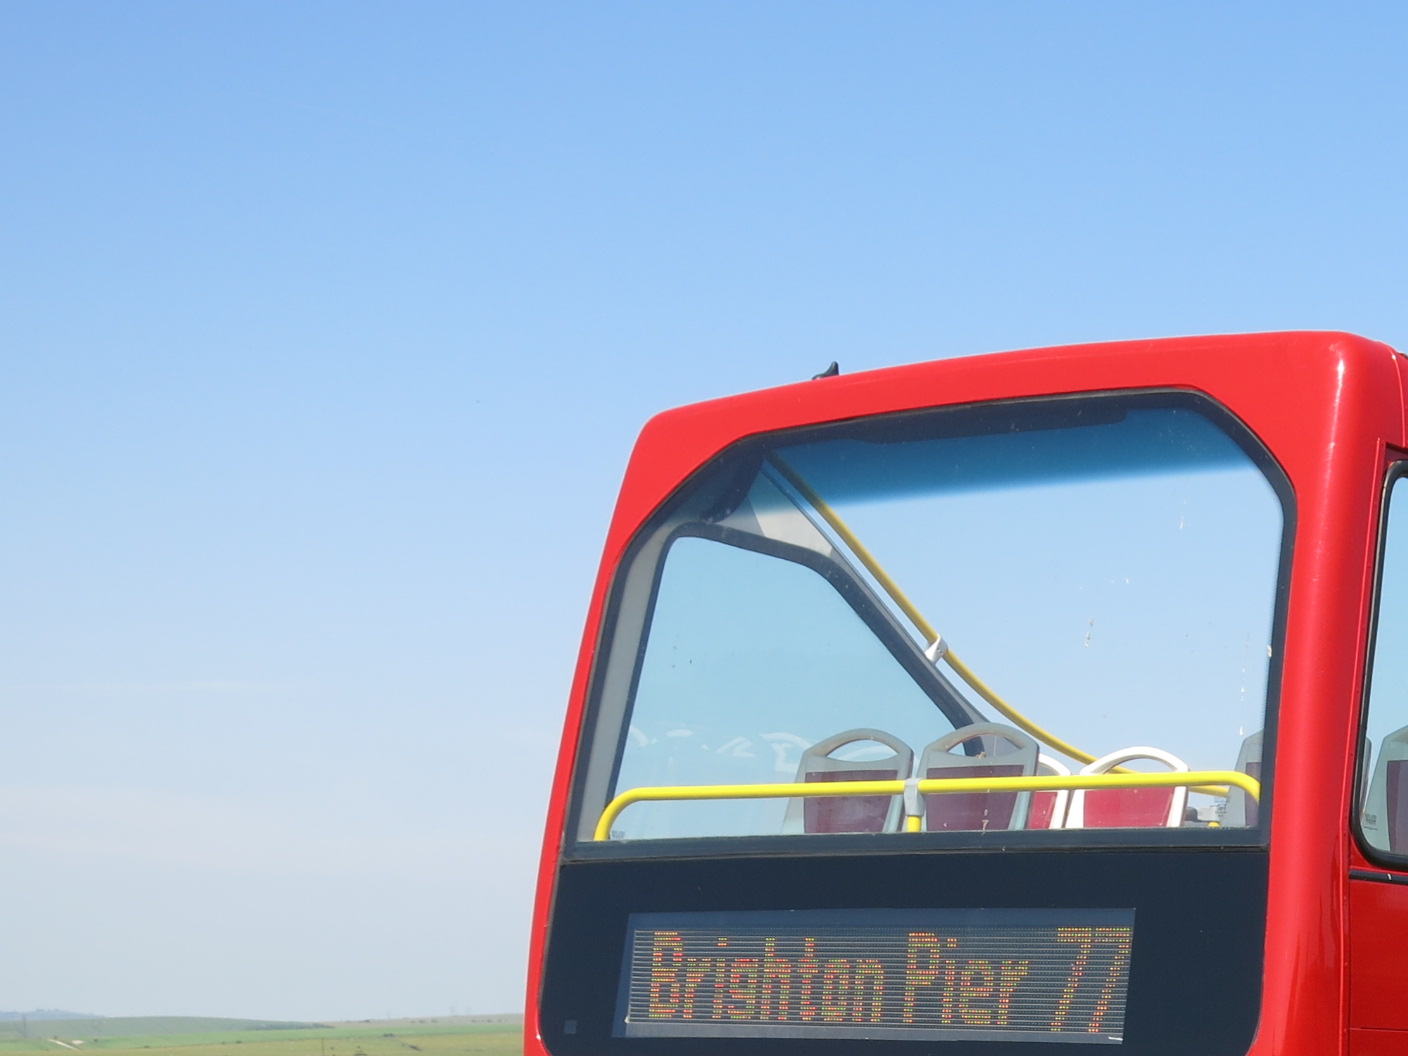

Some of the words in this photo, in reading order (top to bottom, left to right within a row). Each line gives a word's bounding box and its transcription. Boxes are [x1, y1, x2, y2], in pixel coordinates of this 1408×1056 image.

[648, 932, 883, 1021] Brighton
[903, 932, 1029, 1026] Pier
[1051, 927, 1130, 1033] 77
